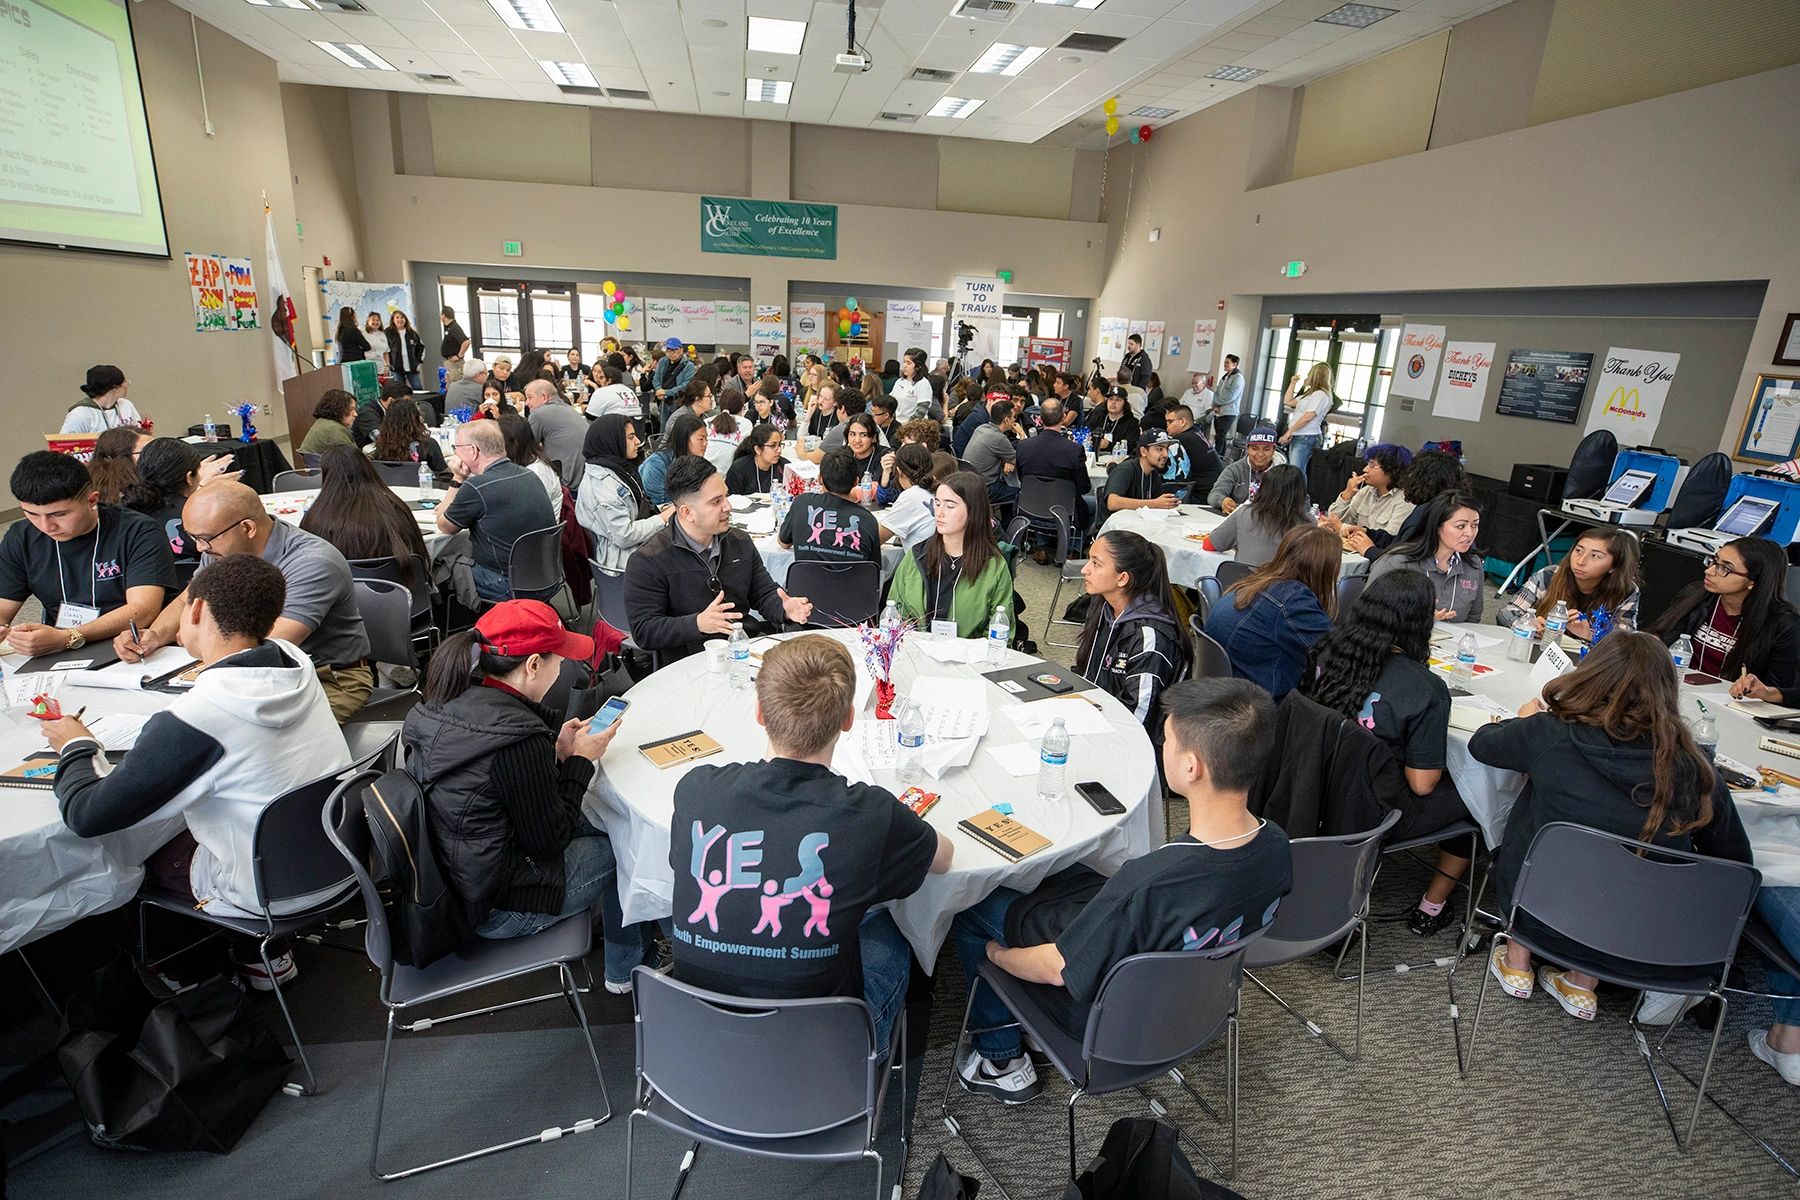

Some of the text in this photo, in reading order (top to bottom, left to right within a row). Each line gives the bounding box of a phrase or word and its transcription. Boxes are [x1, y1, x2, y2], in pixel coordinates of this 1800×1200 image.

[755, 213, 832, 227] Celebrating 10 Years
[768, 226, 819, 236] of Excellence
[189, 257, 220, 287] ZAP
[966, 282, 995, 292] TURN
[972, 293, 987, 302] TO
[961, 303, 997, 313] TRAVIS
[1403, 333, 1442, 351] Thank You
[1445, 351, 1472, 366] Thank
[1472, 353, 1491, 370] You
[1604, 357, 1643, 377] Thank
[1643, 362, 1673, 384] You
[1609, 405, 1646, 418] McDonald's
[1250, 434, 1275, 442] HURLEY
[807, 505, 861, 534] YES
[690, 820, 830, 899] YES
[694, 935, 787, 959] Empowerment
[790, 943, 840, 960] Summit
